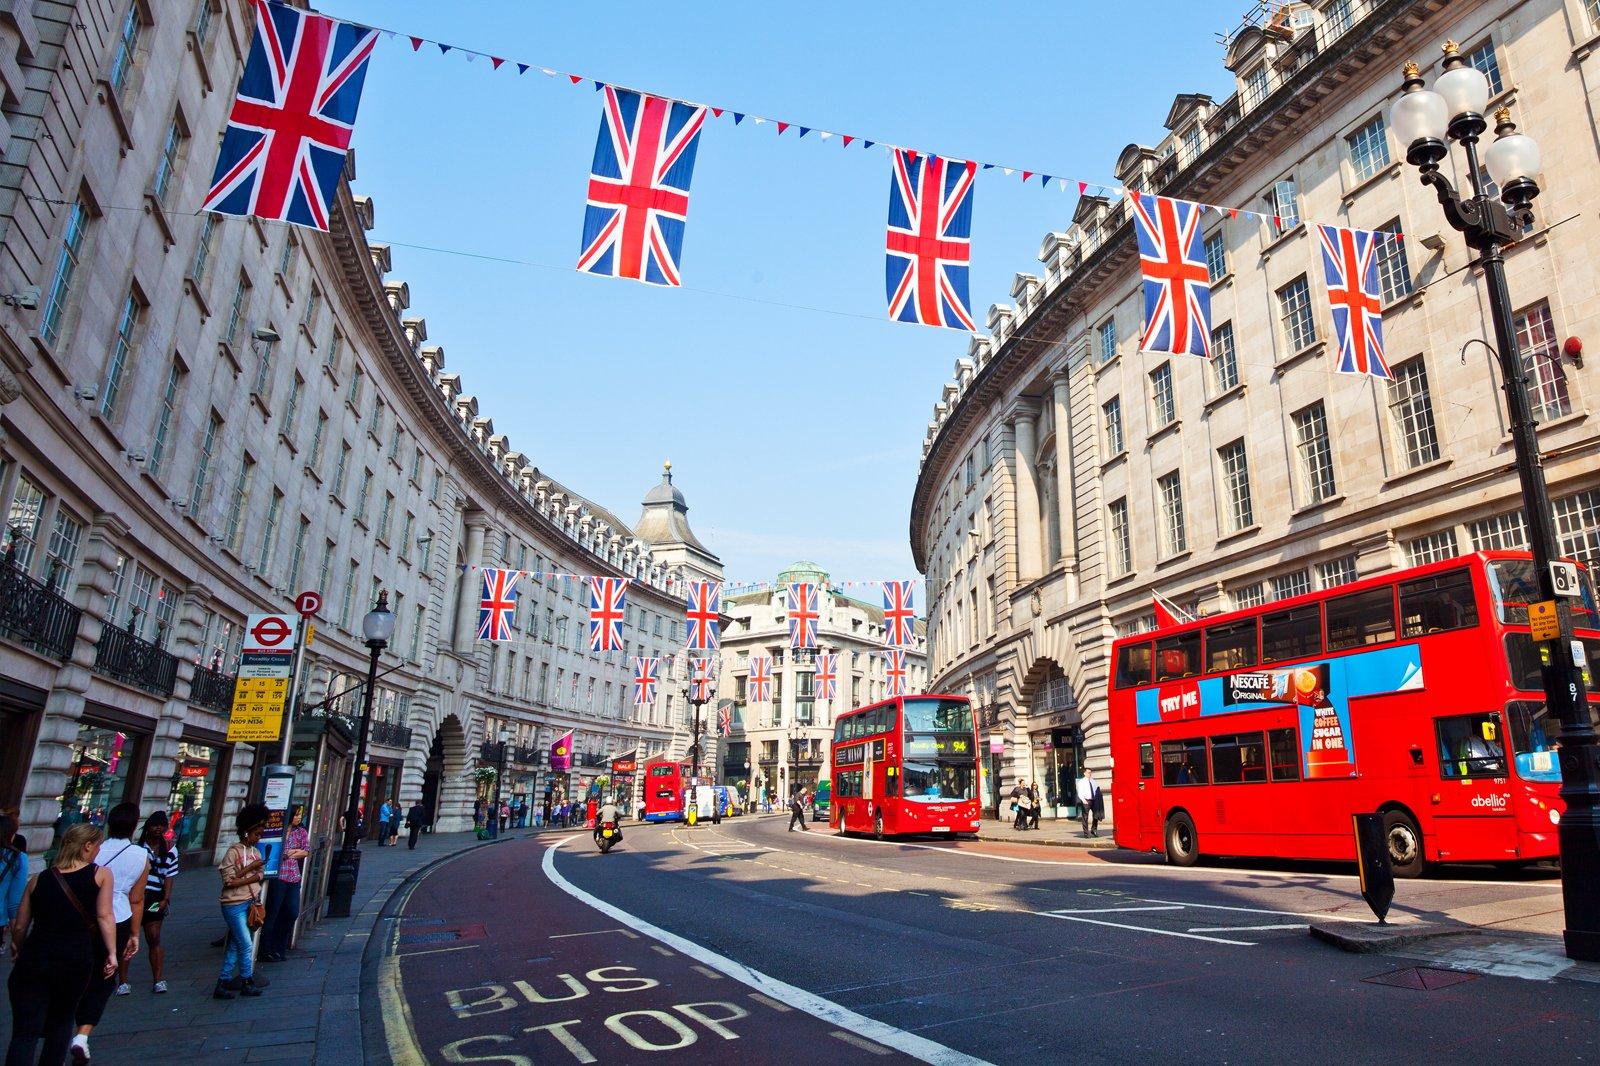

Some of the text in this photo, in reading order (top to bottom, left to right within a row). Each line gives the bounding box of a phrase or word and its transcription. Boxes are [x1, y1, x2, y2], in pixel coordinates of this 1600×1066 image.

[302, 596, 318, 612] D
[1161, 691, 1198, 713] TRY ME
[1315, 706, 1334, 717] WHITE
[1314, 716, 1338, 728] COFFEE
[1314, 727, 1341, 738] SUGAR
[952, 740, 967, 752] 94
[1312, 737, 1343, 751] IN ONE
[1471, 794, 1506, 807] abellio
[444, 966, 661, 1019] BUS
[438, 1001, 751, 1066] STOP
